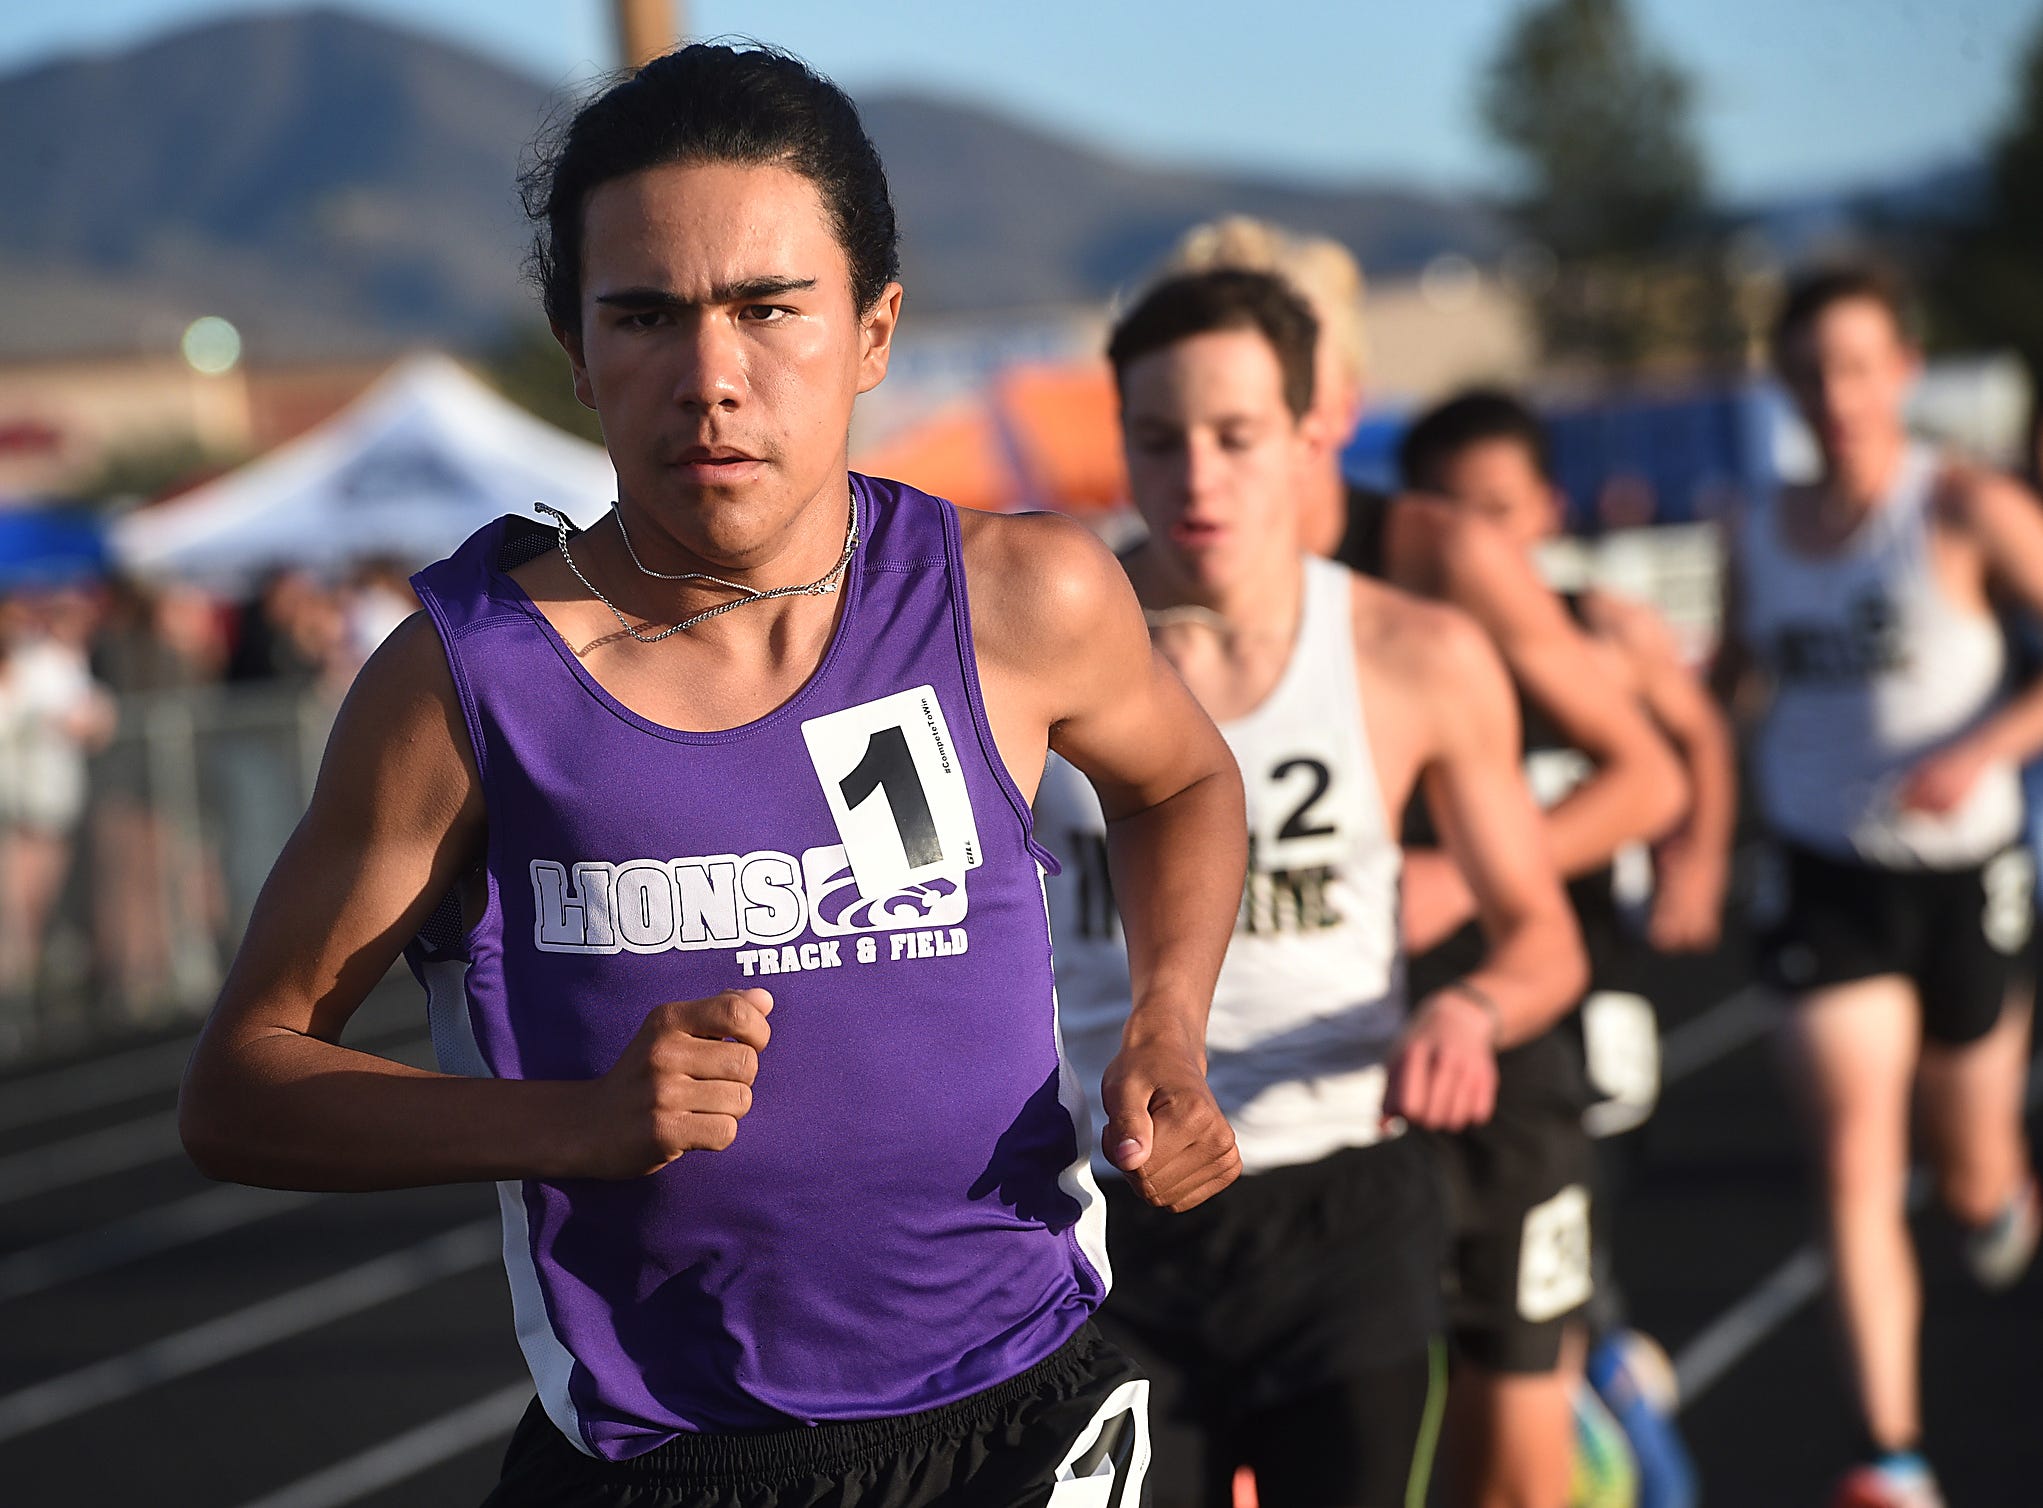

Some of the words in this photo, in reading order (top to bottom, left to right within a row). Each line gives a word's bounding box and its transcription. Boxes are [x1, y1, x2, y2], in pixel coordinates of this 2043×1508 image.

[921, 697, 952, 774] #CompeteToWin
[838, 725, 945, 870] 1
[1269, 757, 1337, 841] 2
[532, 853, 806, 951] LIONS
[736, 940, 842, 977] TRACK
[857, 936, 878, 964] &
[890, 927, 969, 961] FIELD
